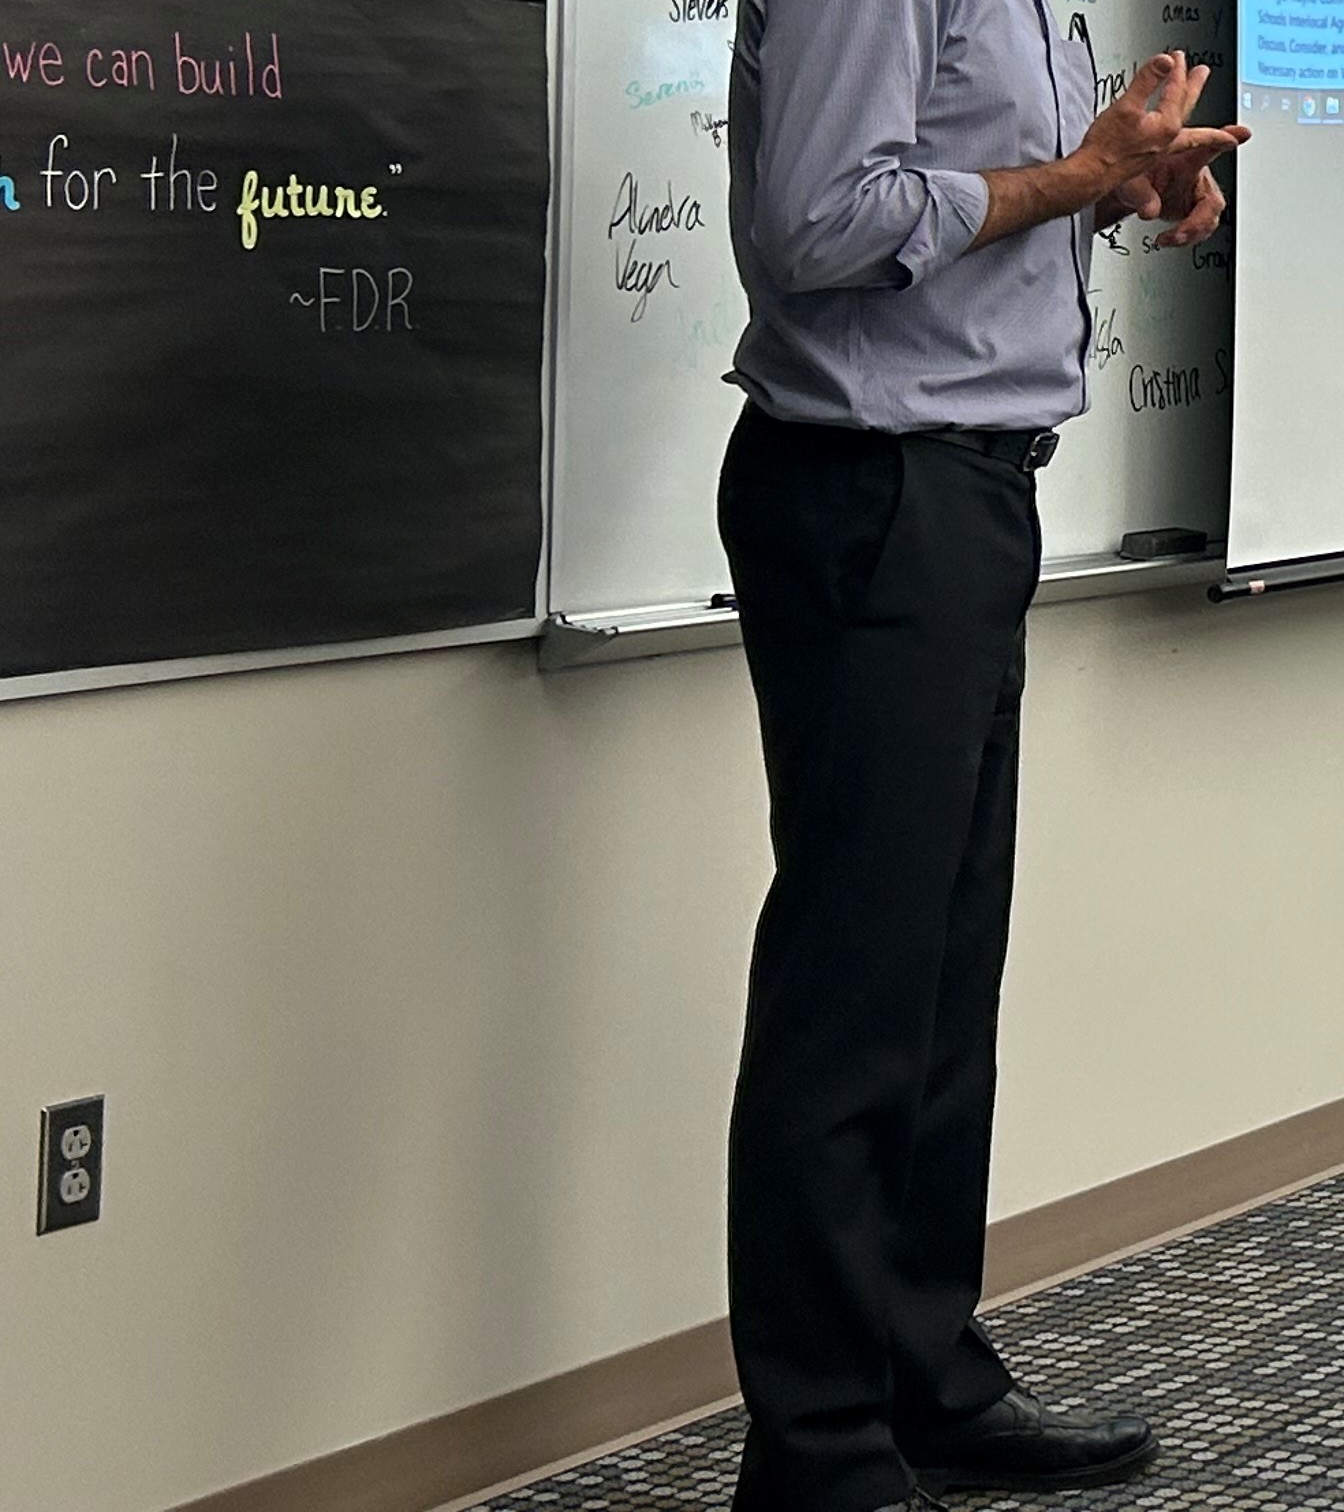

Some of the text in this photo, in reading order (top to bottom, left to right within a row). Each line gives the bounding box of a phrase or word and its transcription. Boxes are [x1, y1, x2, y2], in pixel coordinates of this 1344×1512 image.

[3, 31, 283, 99] we can build
[39, 134, 117, 211] for
[140, 133, 218, 211] the
[1130, 364, 1201, 412] Cristina
